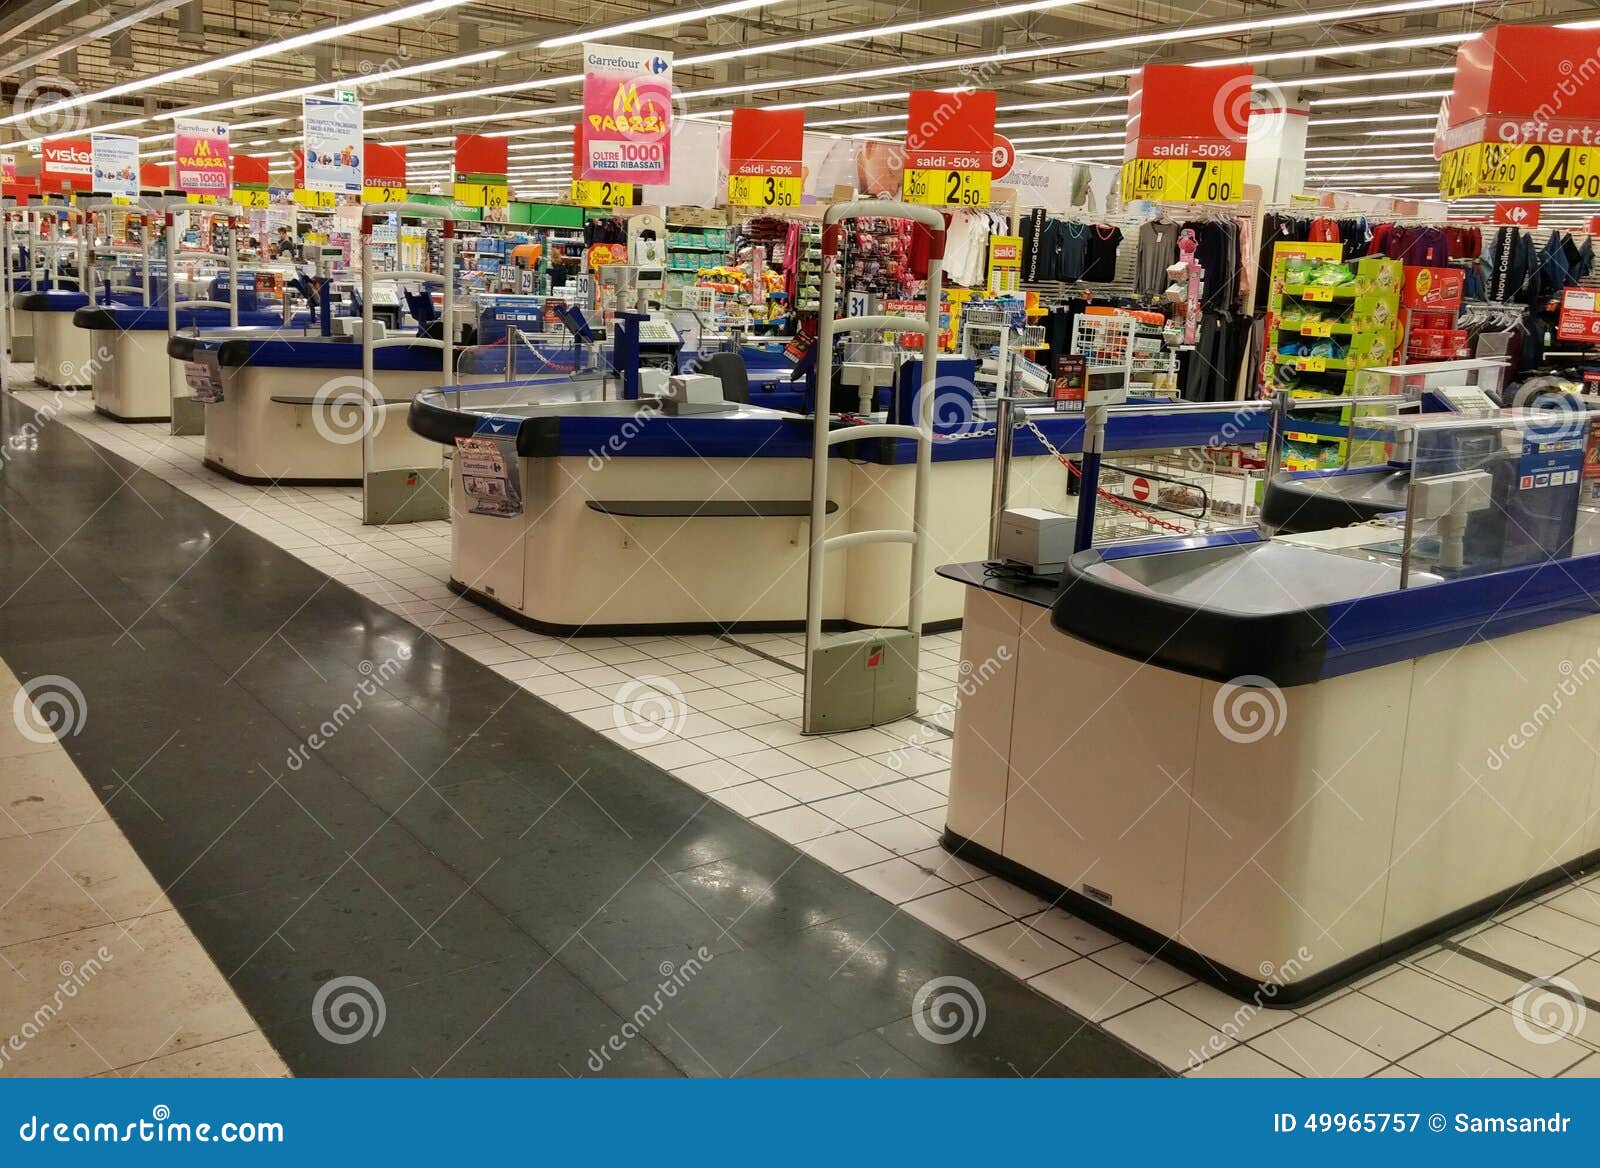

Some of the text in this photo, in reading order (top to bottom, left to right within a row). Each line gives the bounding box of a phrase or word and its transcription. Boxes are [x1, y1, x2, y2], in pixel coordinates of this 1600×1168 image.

[588, 54, 640, 69] Carrefour
[592, 144, 660, 161] OLTRE 1000
[1152, 143, 1231, 157] saldi -50%
[592, 160, 661, 169] PREZZI RIBASSATI
[916, 156, 980, 168] saldi -50%
[740, 164, 792, 175] saldi -50%
[199, 173, 224, 183] 1000
[365, 178, 402, 187] Offerta
[994, 247, 1016, 257] saldi
[1027, 209, 1042, 282] Nuova Collezione
[1495, 227, 1513, 300] Nuova Collezione
[522, 274, 531, 288] 29
[578, 279, 588, 294] 30
[850, 297, 864, 316] 31
[887, 302, 914, 311] Ricarica
